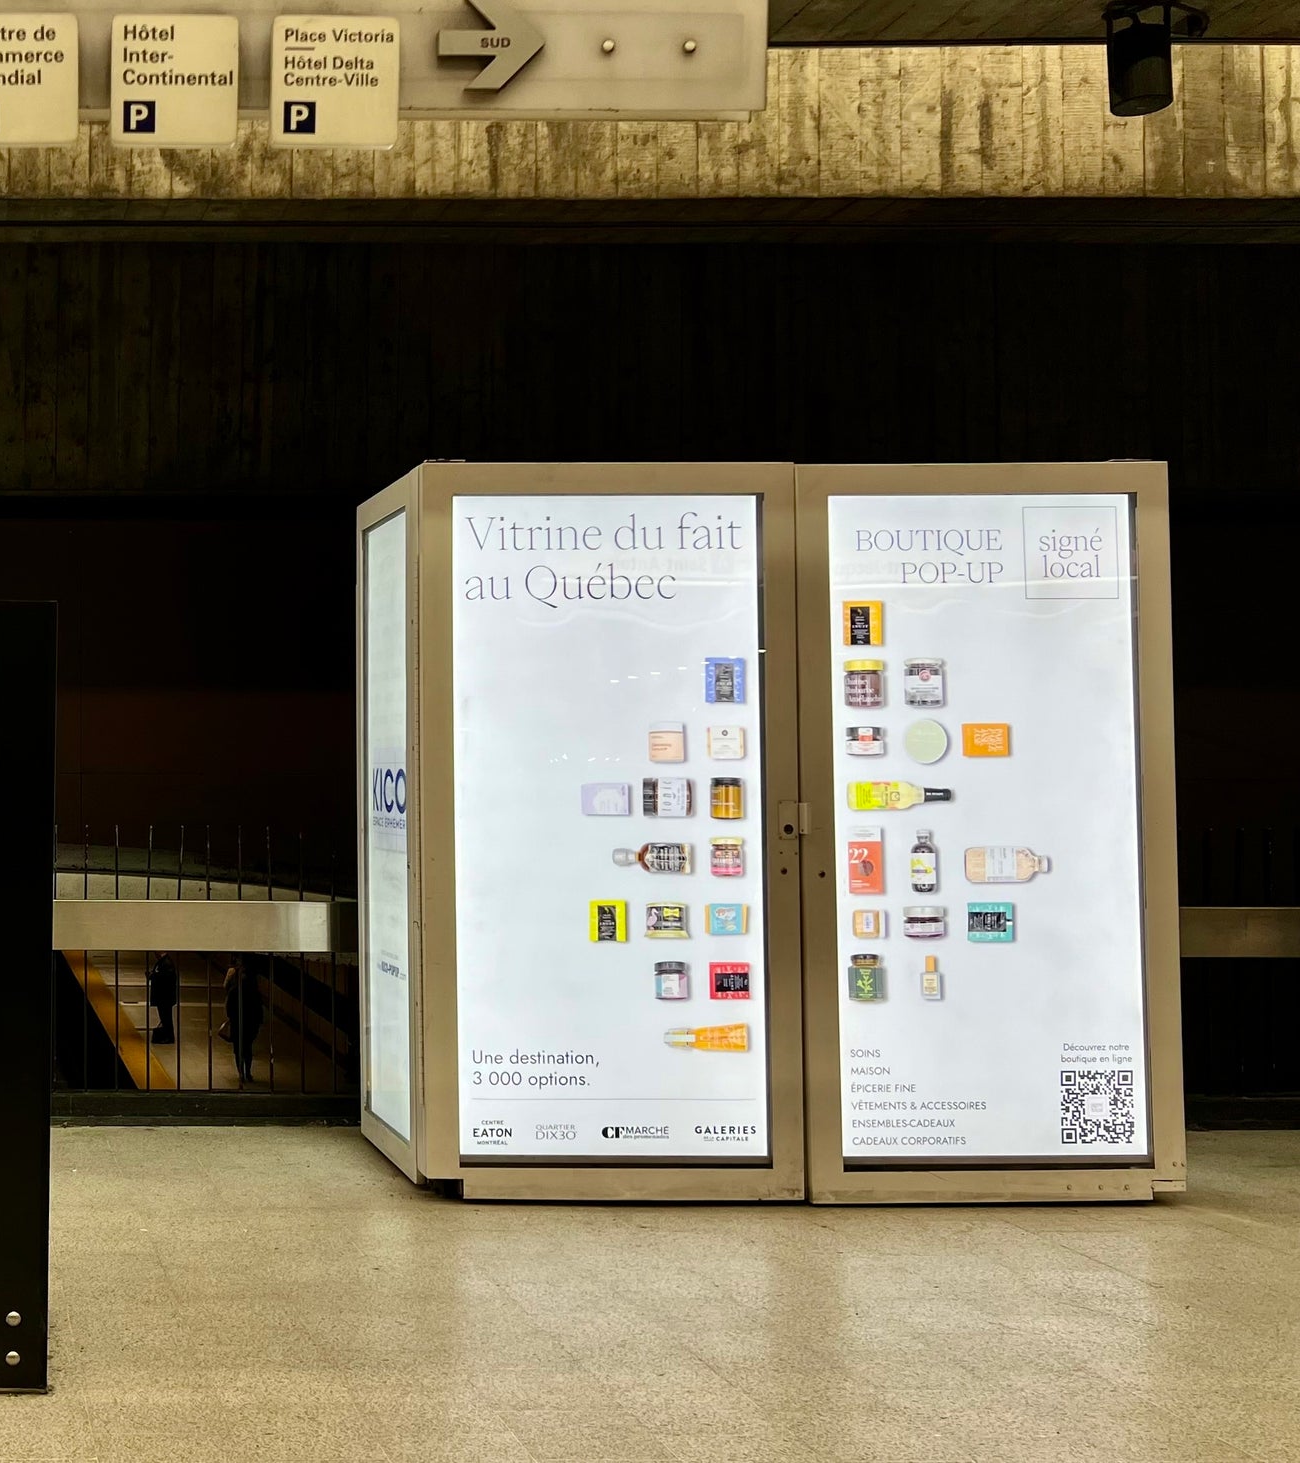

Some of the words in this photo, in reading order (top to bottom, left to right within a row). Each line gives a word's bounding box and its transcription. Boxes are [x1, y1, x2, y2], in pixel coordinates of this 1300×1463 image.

[33, 24, 56, 42] de
[123, 23, 175, 42] Hôtel
[284, 27, 327, 43] Place
[331, 27, 395, 43] Victoria
[480, 36, 512, 49] SUD
[123, 46, 174, 64] Inter-
[284, 55, 327, 70] Hôtel
[332, 55, 375, 70] Delta
[122, 68, 234, 86] Continental
[283, 71, 379, 87] Centre-Ville
[129, 103, 149, 131] P
[290, 104, 309, 131] P
[464, 515, 603, 552] Vitrine
[613, 513, 665, 552] du
[676, 511, 744, 551] fait
[855, 528, 1003, 557] BOUTIQUE
[1038, 527, 1103, 560] signé
[900, 561, 1004, 585] POP-UP
[1042, 554, 1102, 579] local
[464, 574, 513, 601] au
[524, 562, 677, 609] Québec
[372, 768, 406, 815] KICO
[848, 847, 869, 864] 22
[849, 1048, 881, 1059] SOINS
[1062, 1042, 1107, 1053] Découvrez
[1108, 1044, 1130, 1052] notre
[471, 1050, 504, 1065] Une
[509, 1049, 601, 1068] destination,
[1060, 1054, 1098, 1064] boutique
[1099, 1055, 1110, 1063] en
[1111, 1054, 1133, 1065] ligne
[850, 1066, 891, 1076] MAISON
[472, 1072, 483, 1086] 3
[488, 1072, 523, 1086] 000
[527, 1071, 591, 1090] options.
[850, 1082, 892, 1093] ÉPICERIE
[894, 1084, 917, 1094] FINE
[850, 1098, 908, 1111] VÊTEMENTS
[909, 1101, 918, 1111] &
[919, 1101, 987, 1111] ACCESSOIRES
[694, 1125, 757, 1135] GALERIES
[852, 1118, 956, 1129] ENSEMBLES-CADEAUX
[472, 1127, 513, 1138] EATON
[601, 1126, 625, 1139] CF
[852, 1136, 899, 1146] CADEAUX
[900, 1136, 967, 1146] CORPORATIFS
